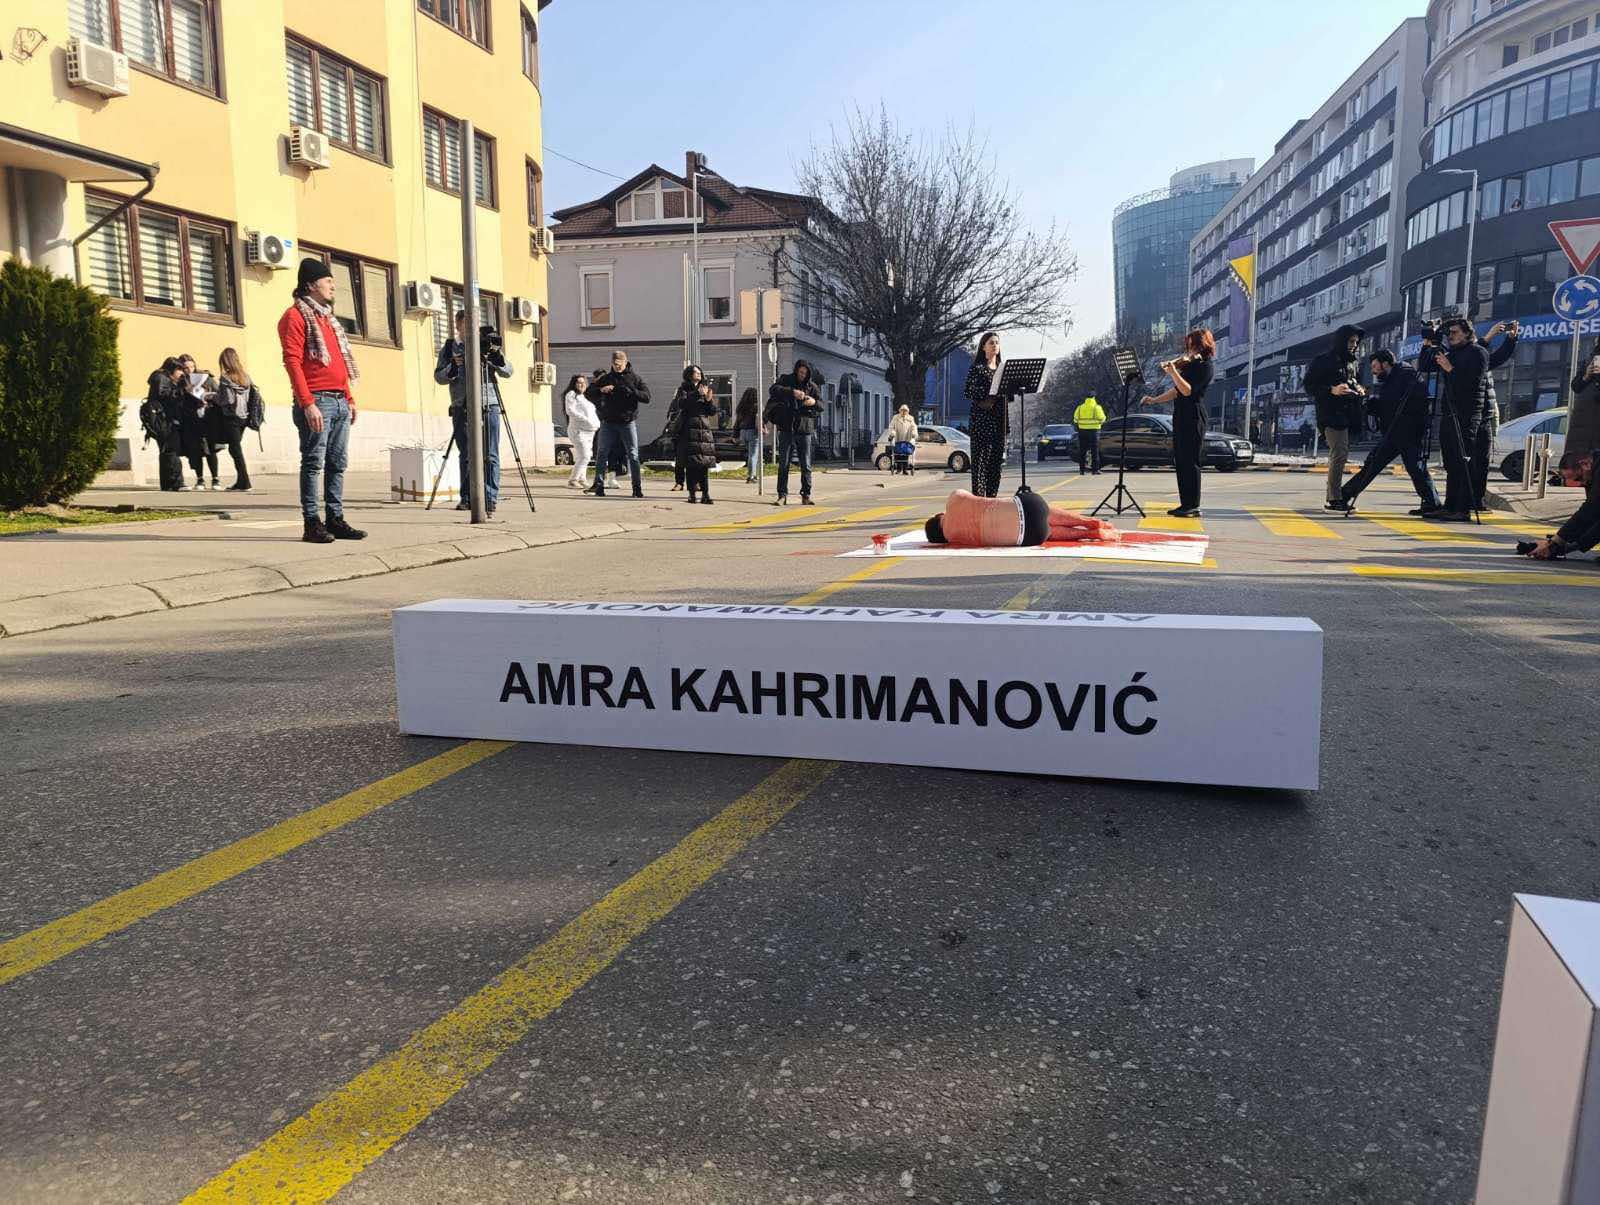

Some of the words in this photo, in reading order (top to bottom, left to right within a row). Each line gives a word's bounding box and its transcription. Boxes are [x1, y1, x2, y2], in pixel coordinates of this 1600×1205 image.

[1516, 318, 1600, 339] PARKASSE
[499, 661, 656, 710] AMRA
[671, 667, 1159, 736] KAHRIMANOVIĆ
